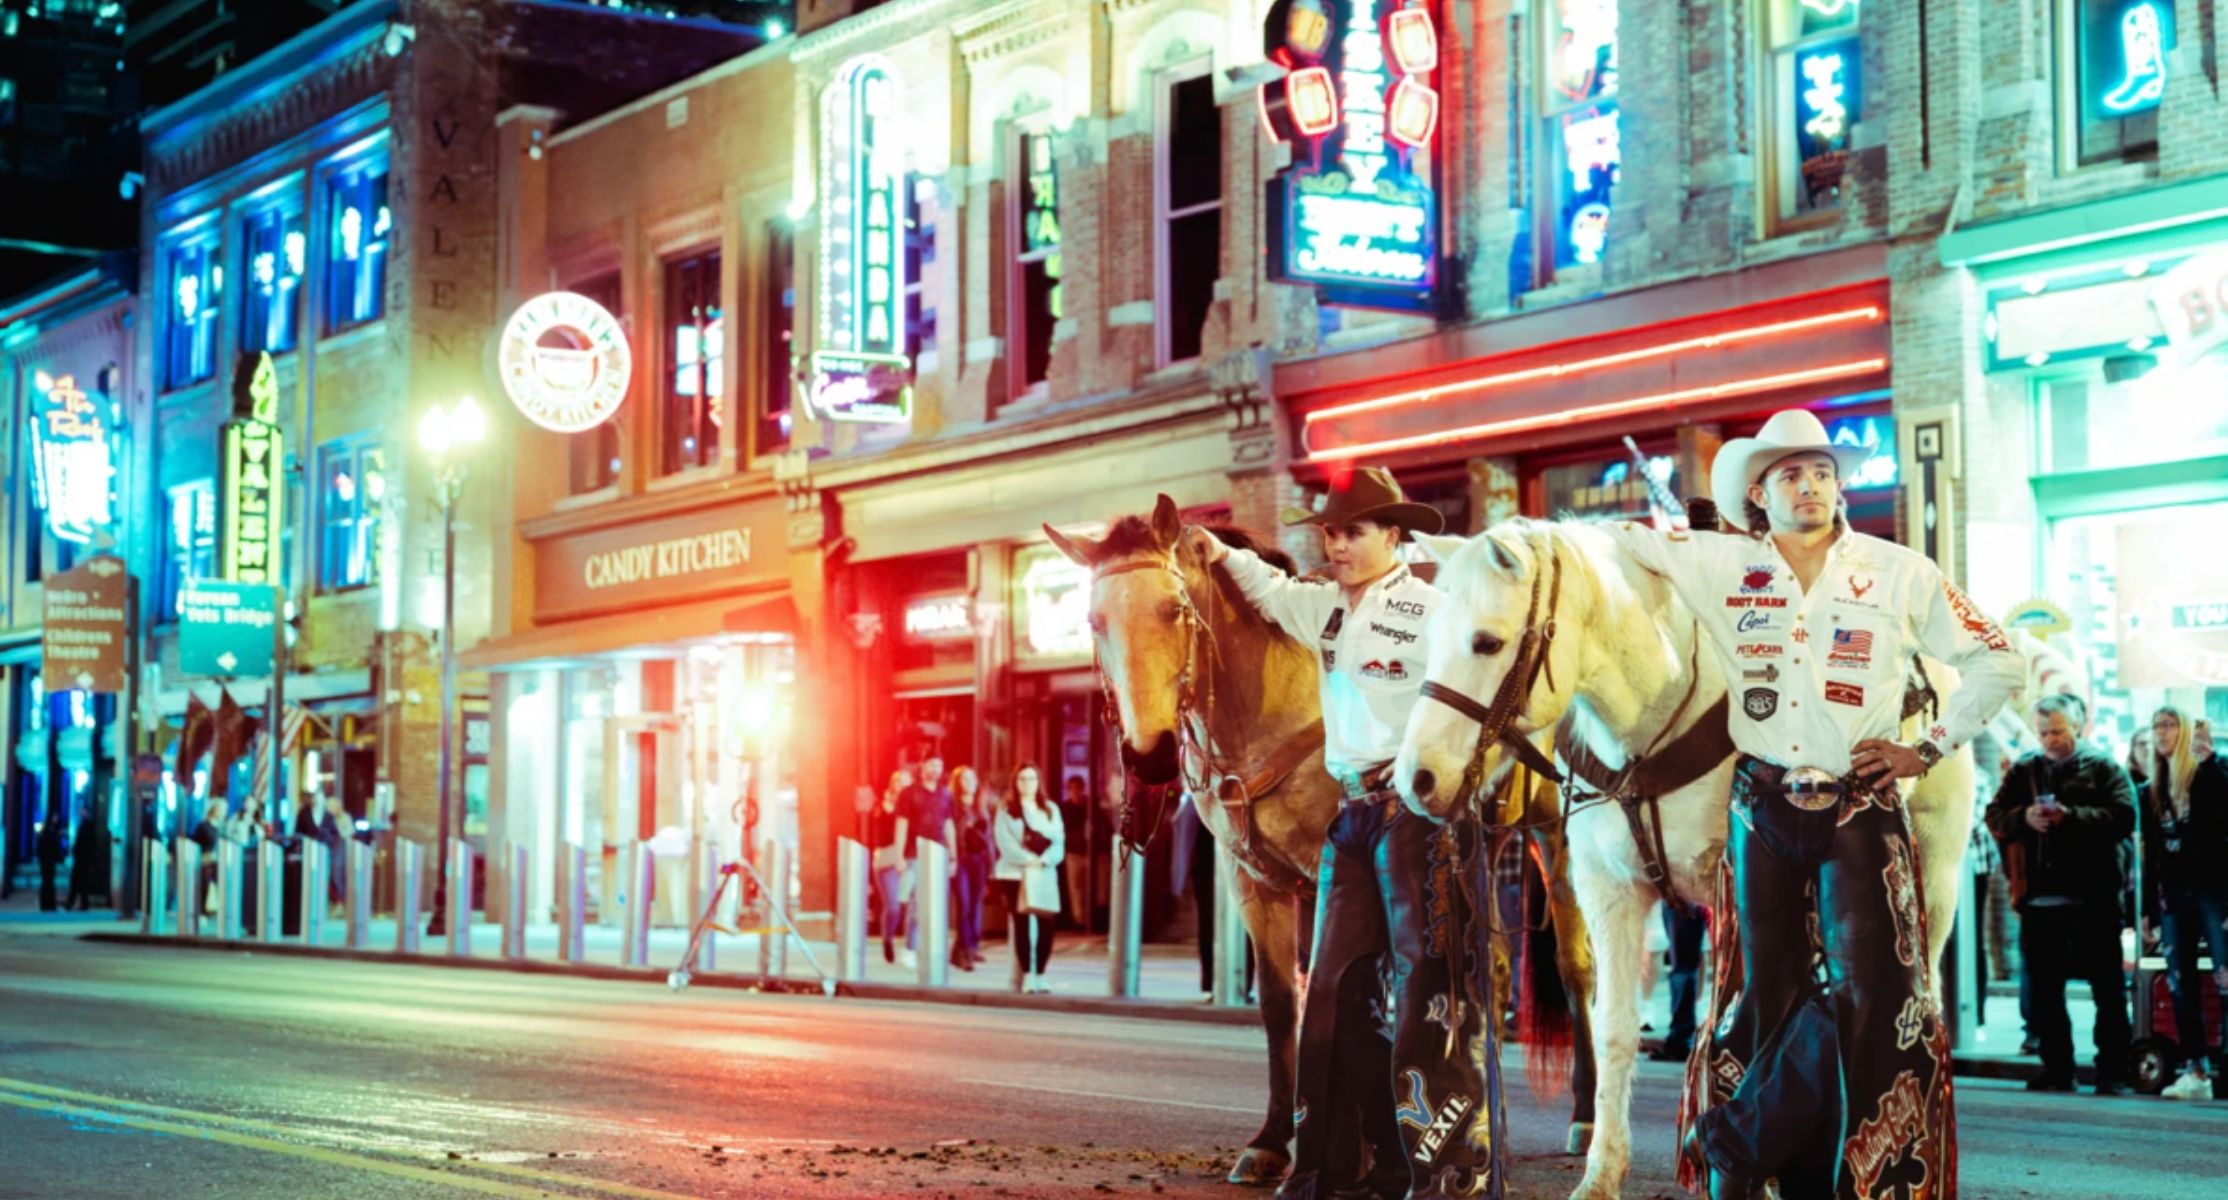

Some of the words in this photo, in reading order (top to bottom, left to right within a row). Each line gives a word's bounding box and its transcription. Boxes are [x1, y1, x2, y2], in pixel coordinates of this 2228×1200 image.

[585, 543, 654, 589] CANDY
[657, 527, 751, 577] KITCHEN
[47, 605, 124, 621] Attractions
[187, 607, 220, 622] Vets
[224, 608, 274, 628] Bridge
[1385, 598, 1425, 616] MCG
[1414, 1097, 1468, 1163] VEXIL
